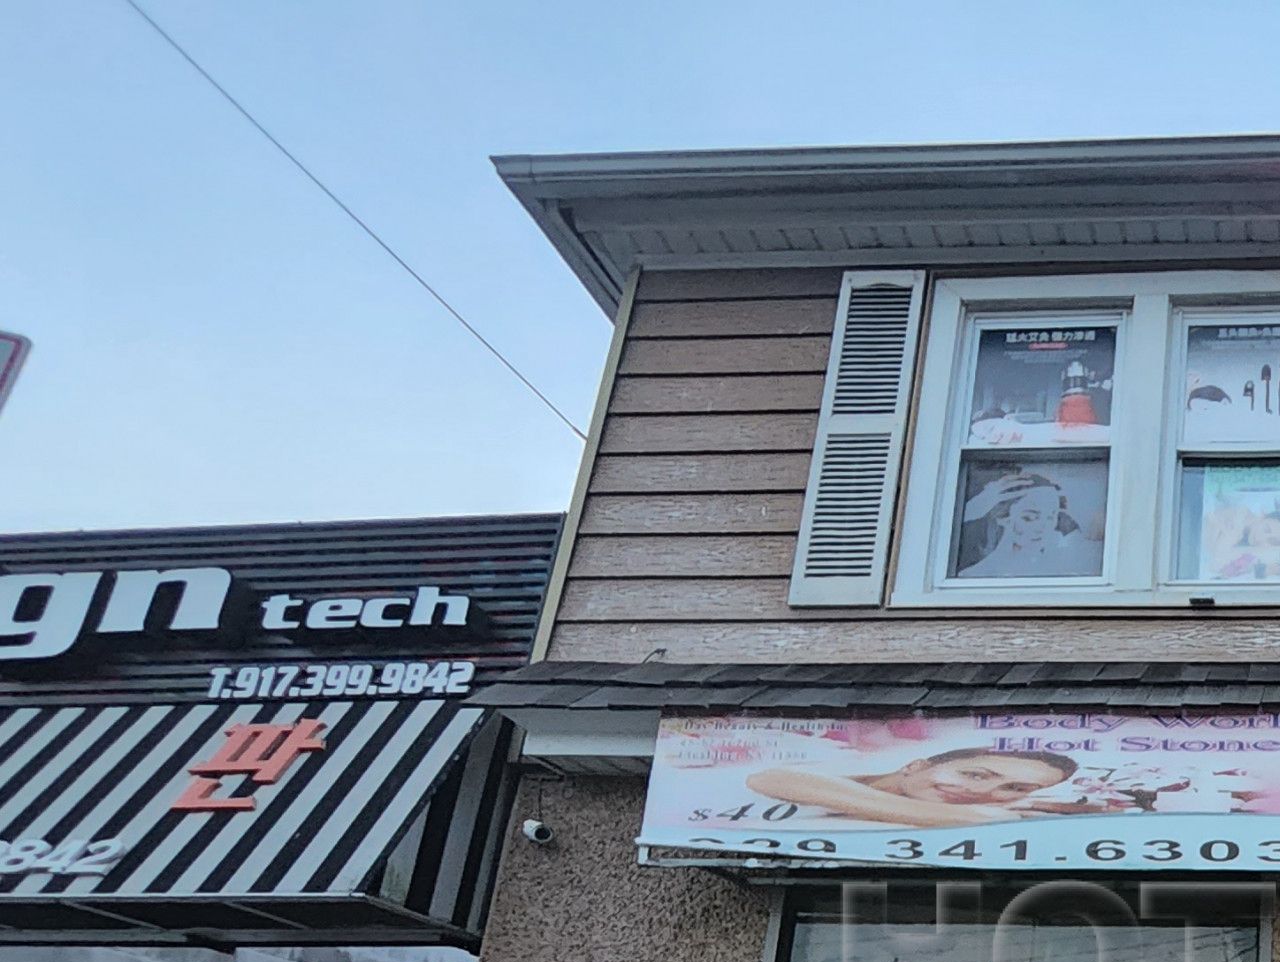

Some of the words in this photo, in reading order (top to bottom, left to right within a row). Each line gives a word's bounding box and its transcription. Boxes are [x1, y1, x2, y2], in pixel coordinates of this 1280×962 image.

[261, 586, 471, 630] tech
[207, 661, 475, 699] T.917.399.9842
[973, 711, 1130, 733] Body
[989, 736, 1102, 752] Hot
[0, 837, 124, 874] 842
